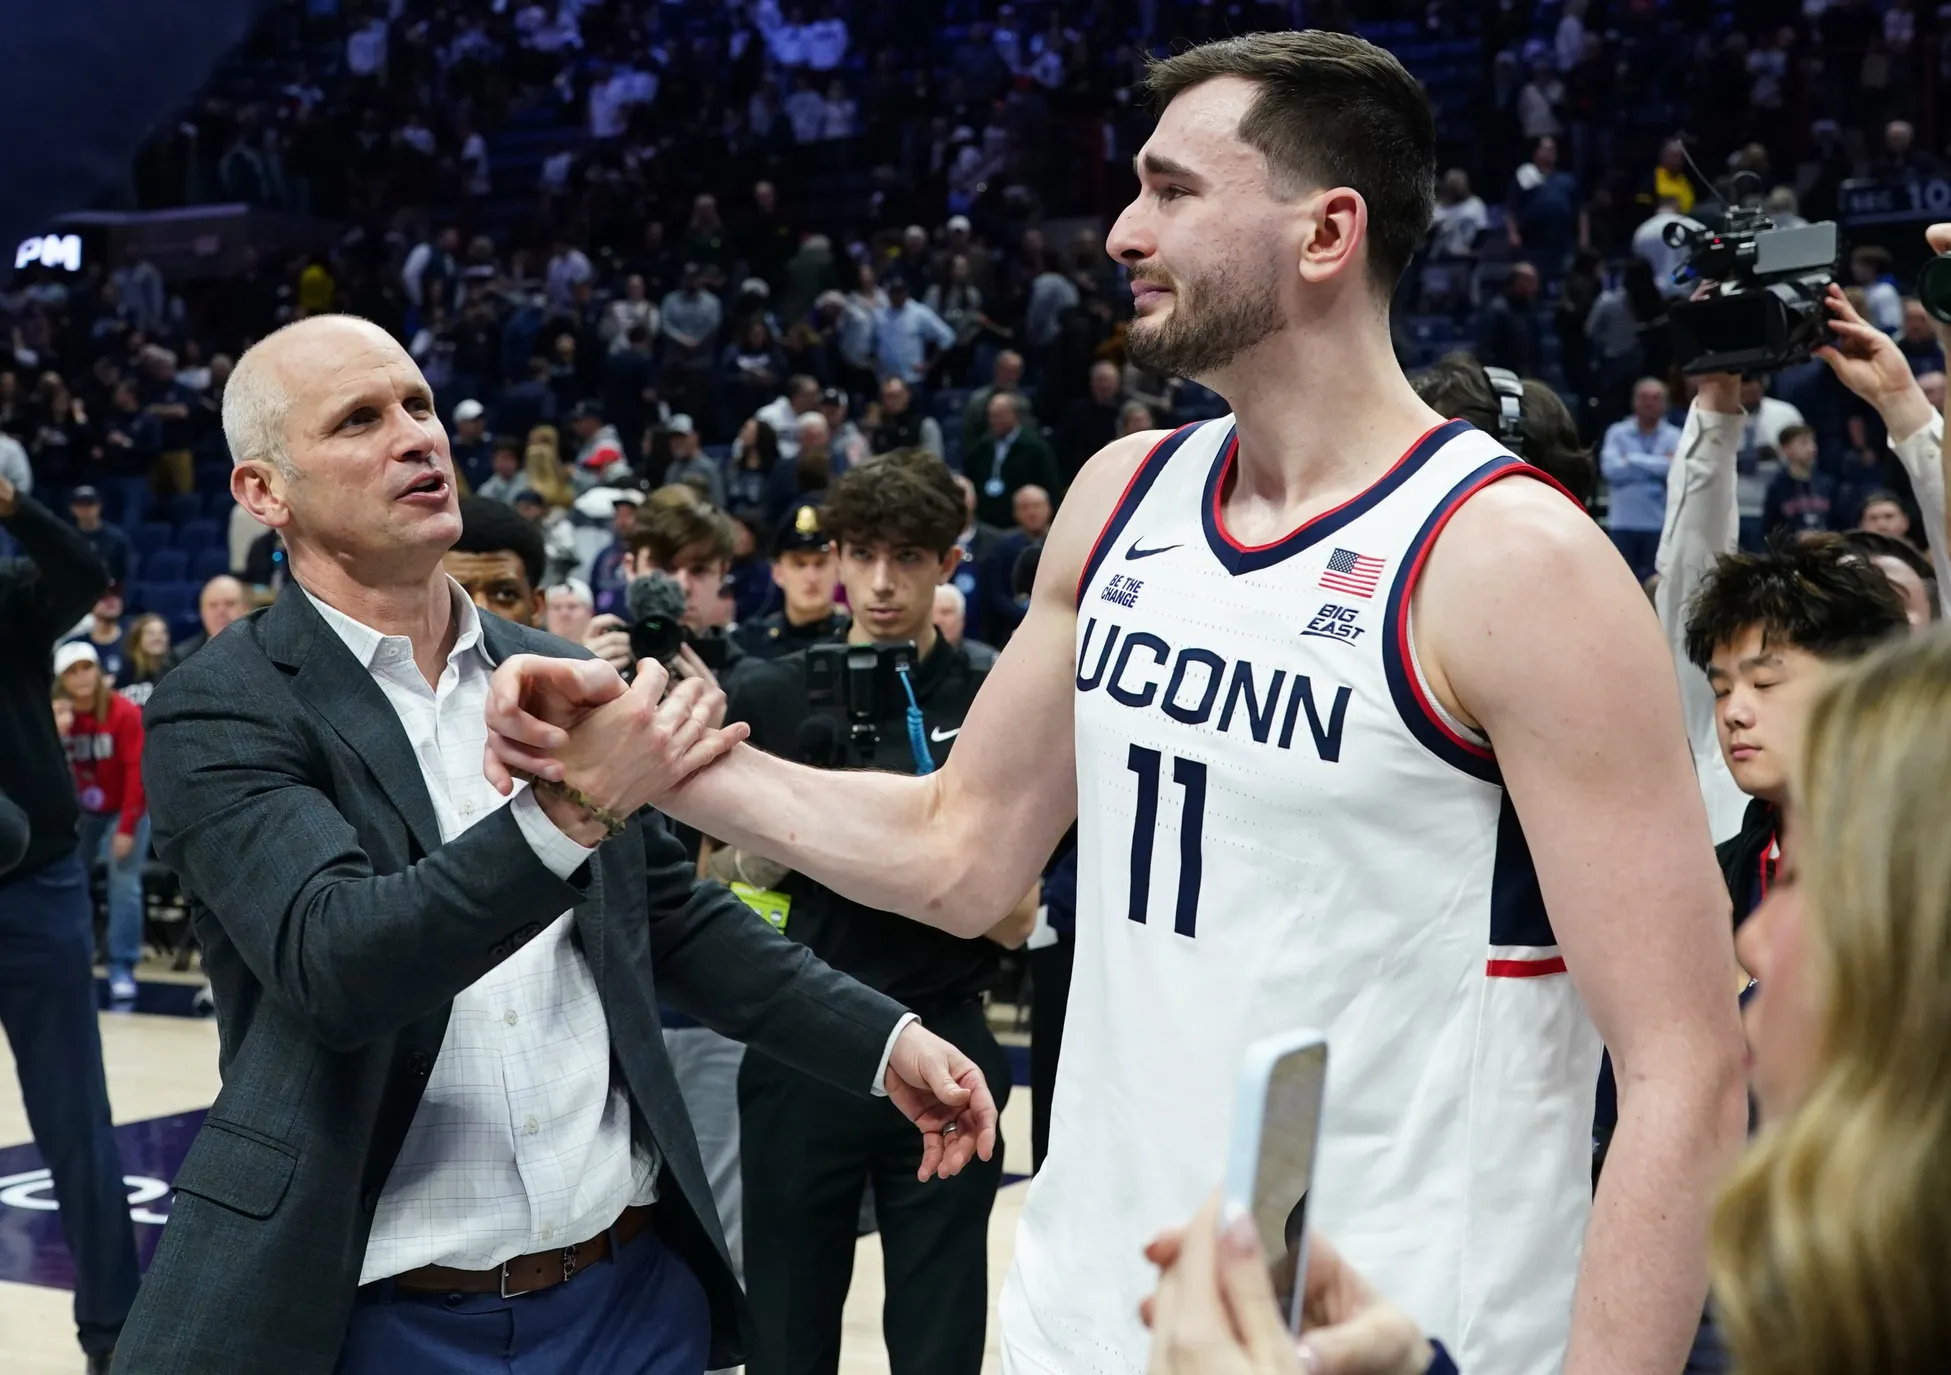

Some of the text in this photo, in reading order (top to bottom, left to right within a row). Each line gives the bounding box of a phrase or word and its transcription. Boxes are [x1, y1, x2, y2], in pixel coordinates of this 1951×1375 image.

[14, 234, 82, 271] PM
[1109, 574, 1144, 593] BE THE
[1100, 586, 1139, 608] CHANGE
[1317, 603, 1360, 623] BIG
[1306, 617, 1365, 640] EAST
[1076, 617, 1352, 763] UCONN
[1127, 743, 1208, 939] 11
